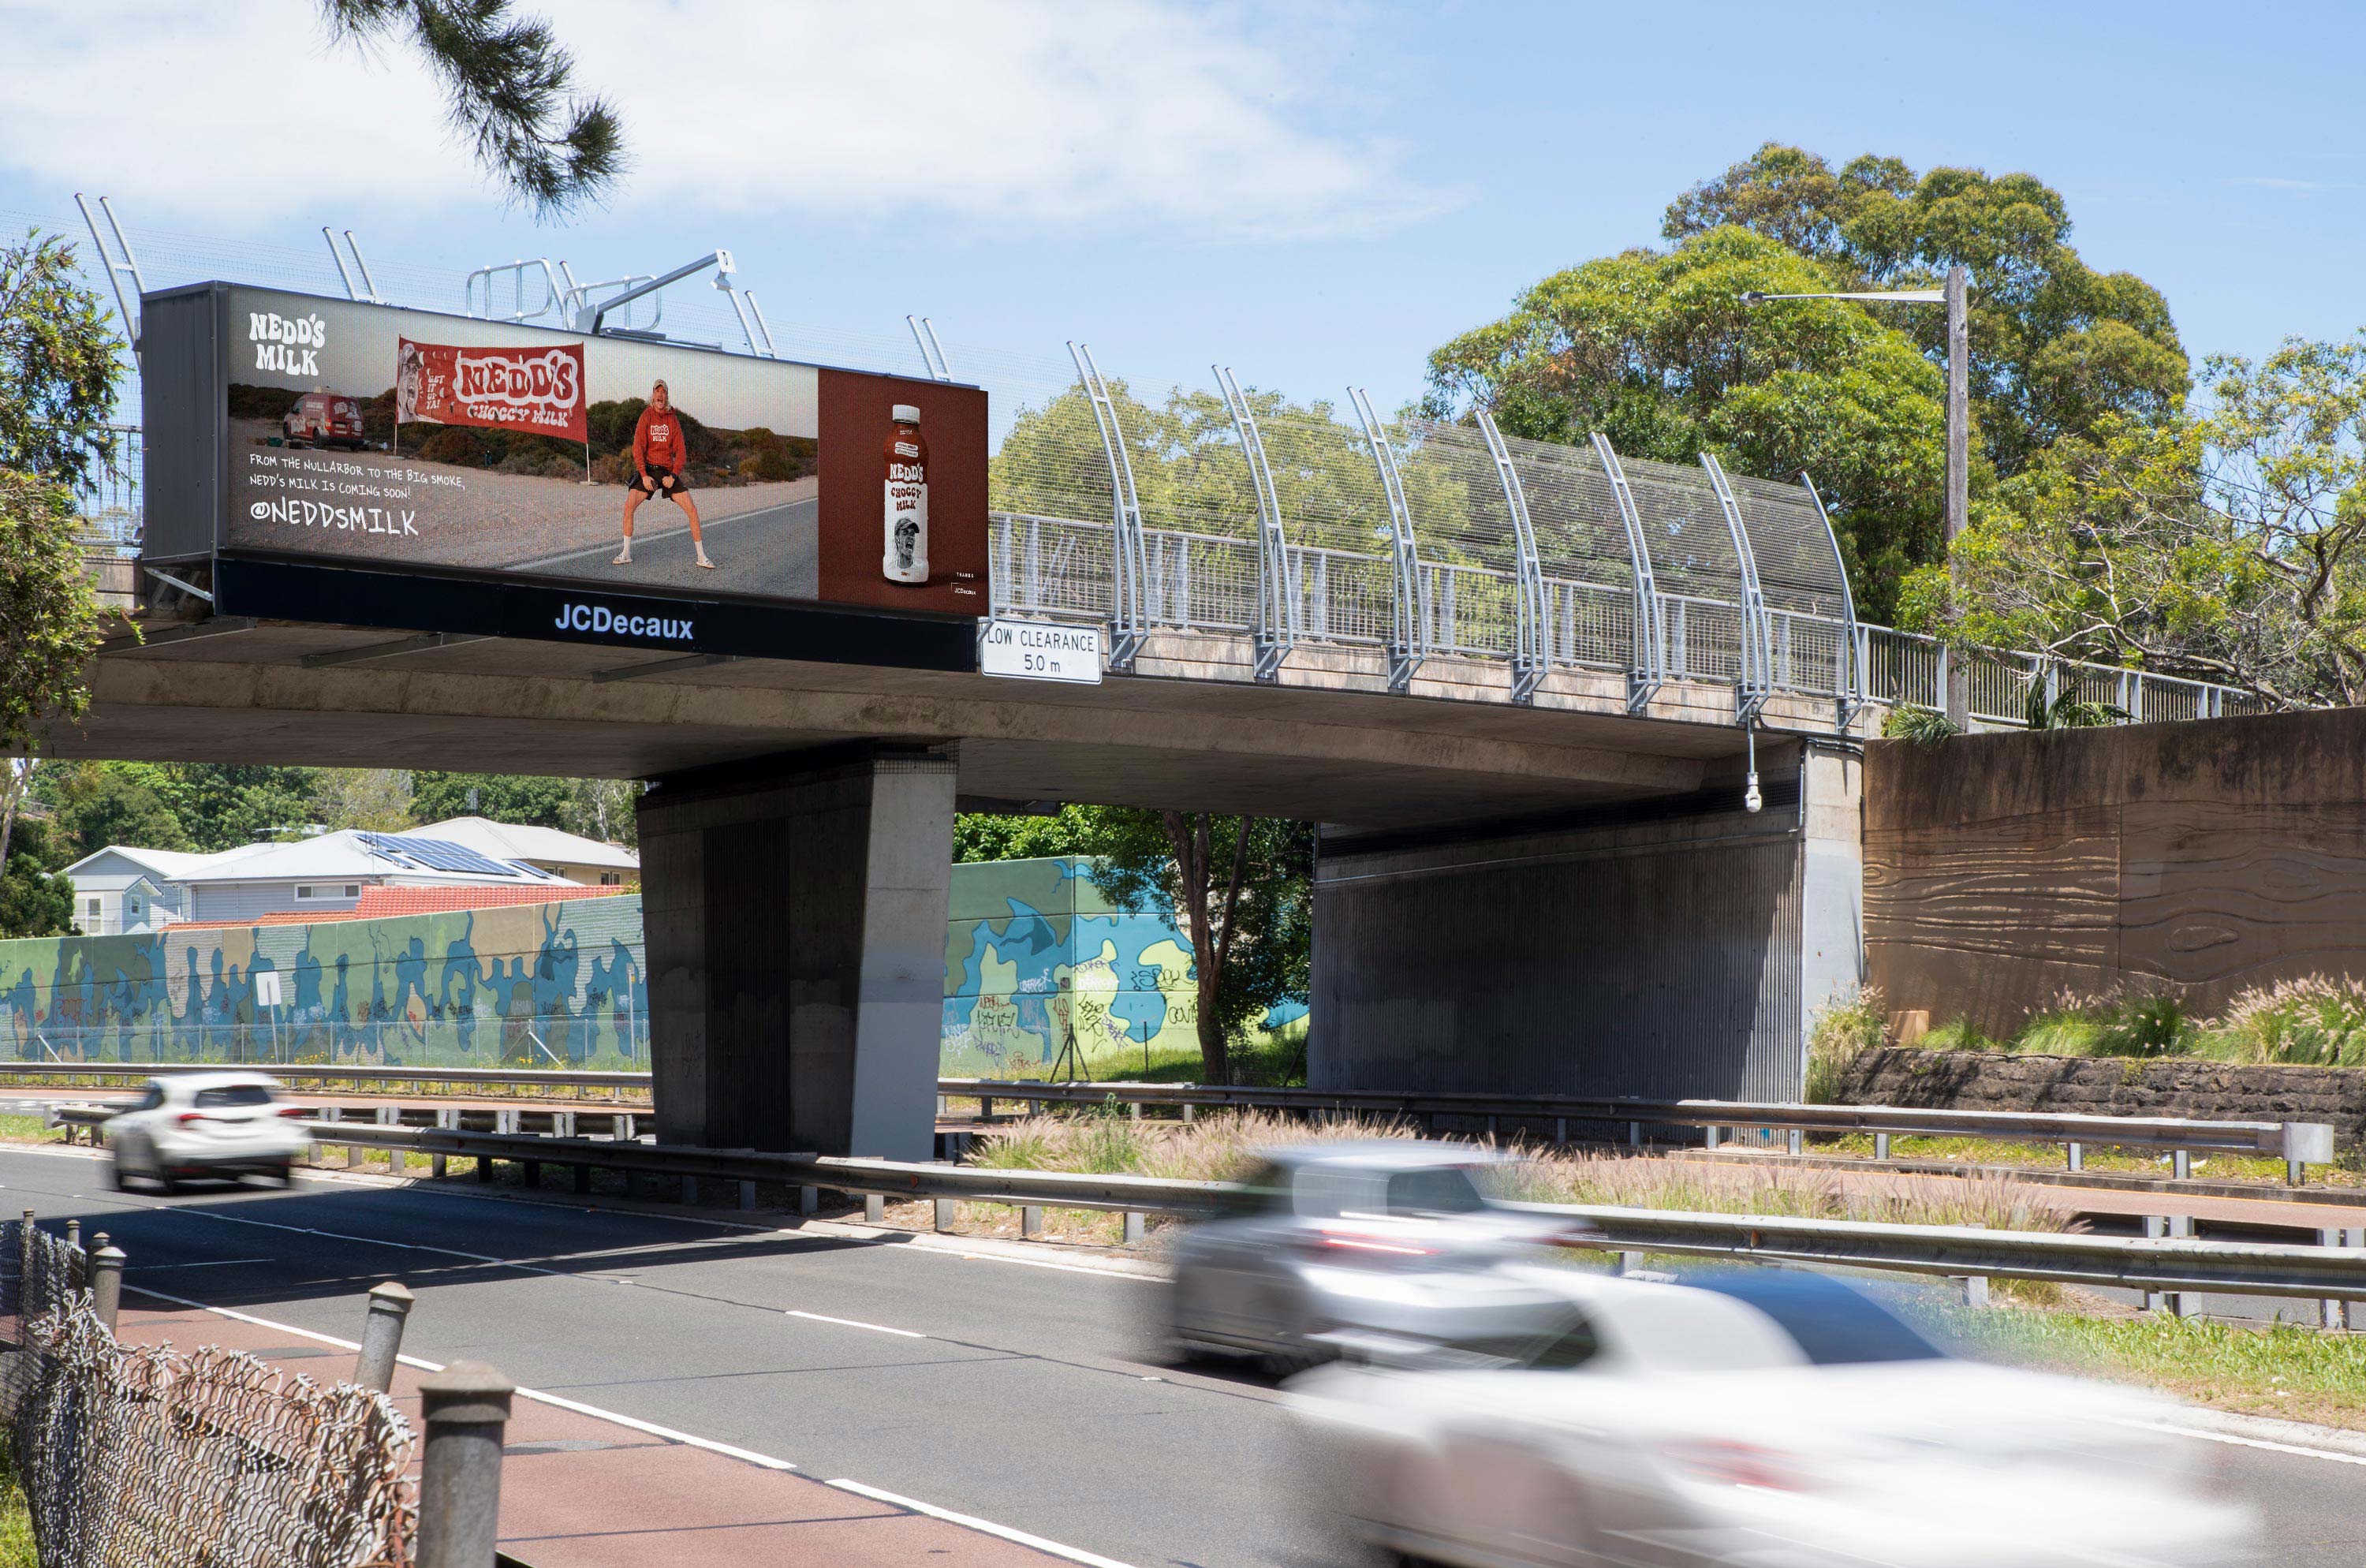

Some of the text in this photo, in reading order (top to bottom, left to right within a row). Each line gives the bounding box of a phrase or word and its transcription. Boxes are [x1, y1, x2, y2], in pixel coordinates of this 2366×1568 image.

[249, 312, 325, 348] NEDD'S
[256, 344, 319, 376] MILK
[456, 351, 578, 408] NEDD'S
[532, 409, 569, 427] MILK
[250, 454, 465, 490] FROM THE NULLARBOR TO THE BIG SMOKE,
[250, 473, 410, 499] NEDD'S MILK IS COMING SOON!
[890, 462, 924, 482] NEDD'S
[251, 496, 419, 536] @NEDDSMILK
[896, 499, 916, 511] MILK
[555, 603, 693, 640] JCDecaux
[987, 628, 1094, 651] LOW CLEARANCE
[1025, 654, 1060, 672] 5.0 m
